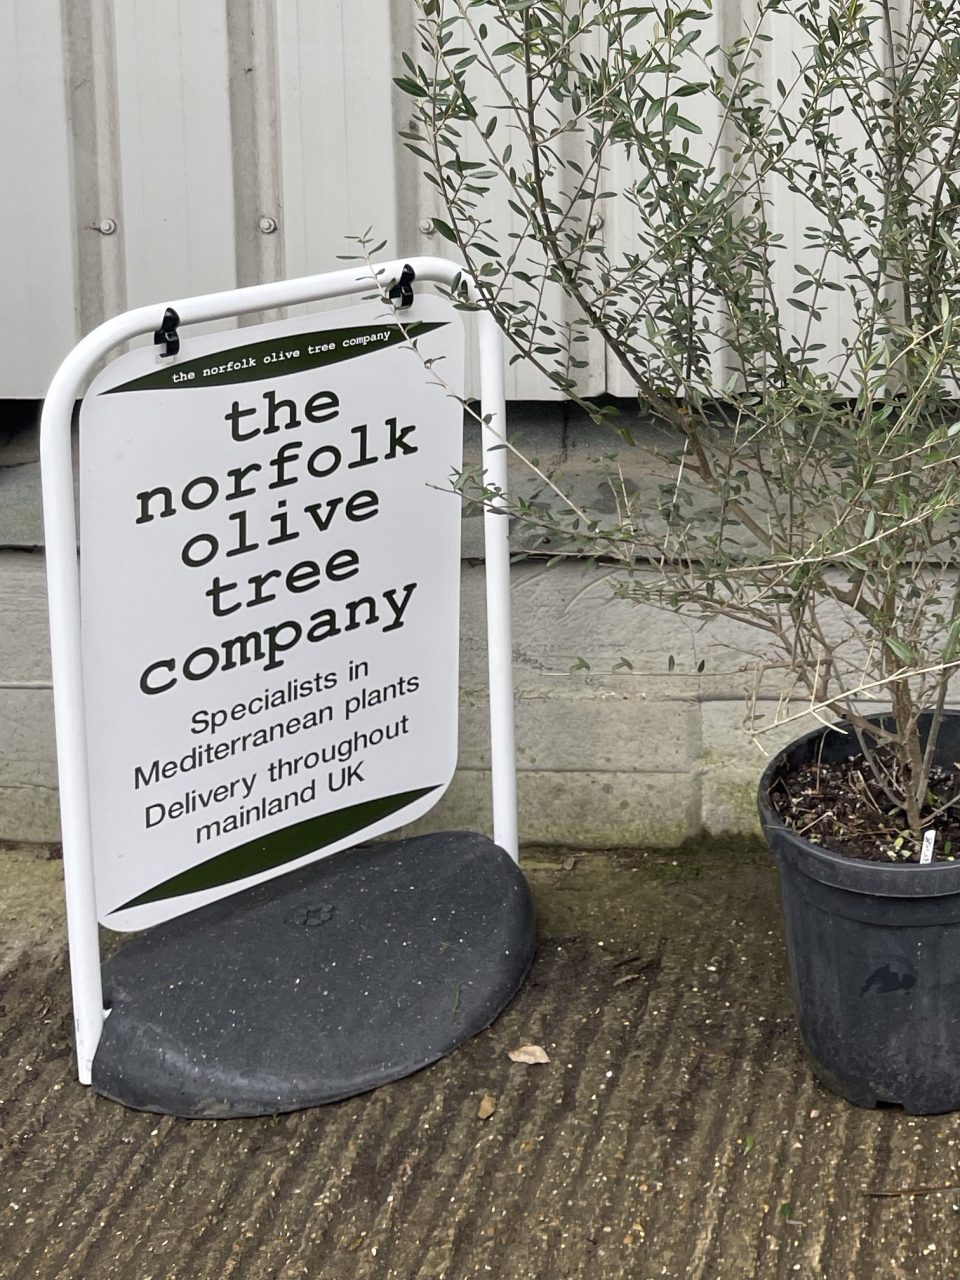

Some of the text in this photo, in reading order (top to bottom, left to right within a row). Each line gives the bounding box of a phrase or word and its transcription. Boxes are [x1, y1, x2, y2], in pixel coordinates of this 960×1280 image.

[172, 329, 392, 383] the norfolk olive tree company
[224, 390, 340, 442] the
[135, 417, 419, 524] norfolk
[181, 489, 379, 568] olive
[205, 548, 360, 617] tree
[139, 582, 418, 695] company
[134, 676, 420, 790] Mediterranean plants
[190, 660, 369, 735] Specialists in
[145, 714, 409, 829] Delivery throughout
[196, 760, 365, 844] mainland UK
